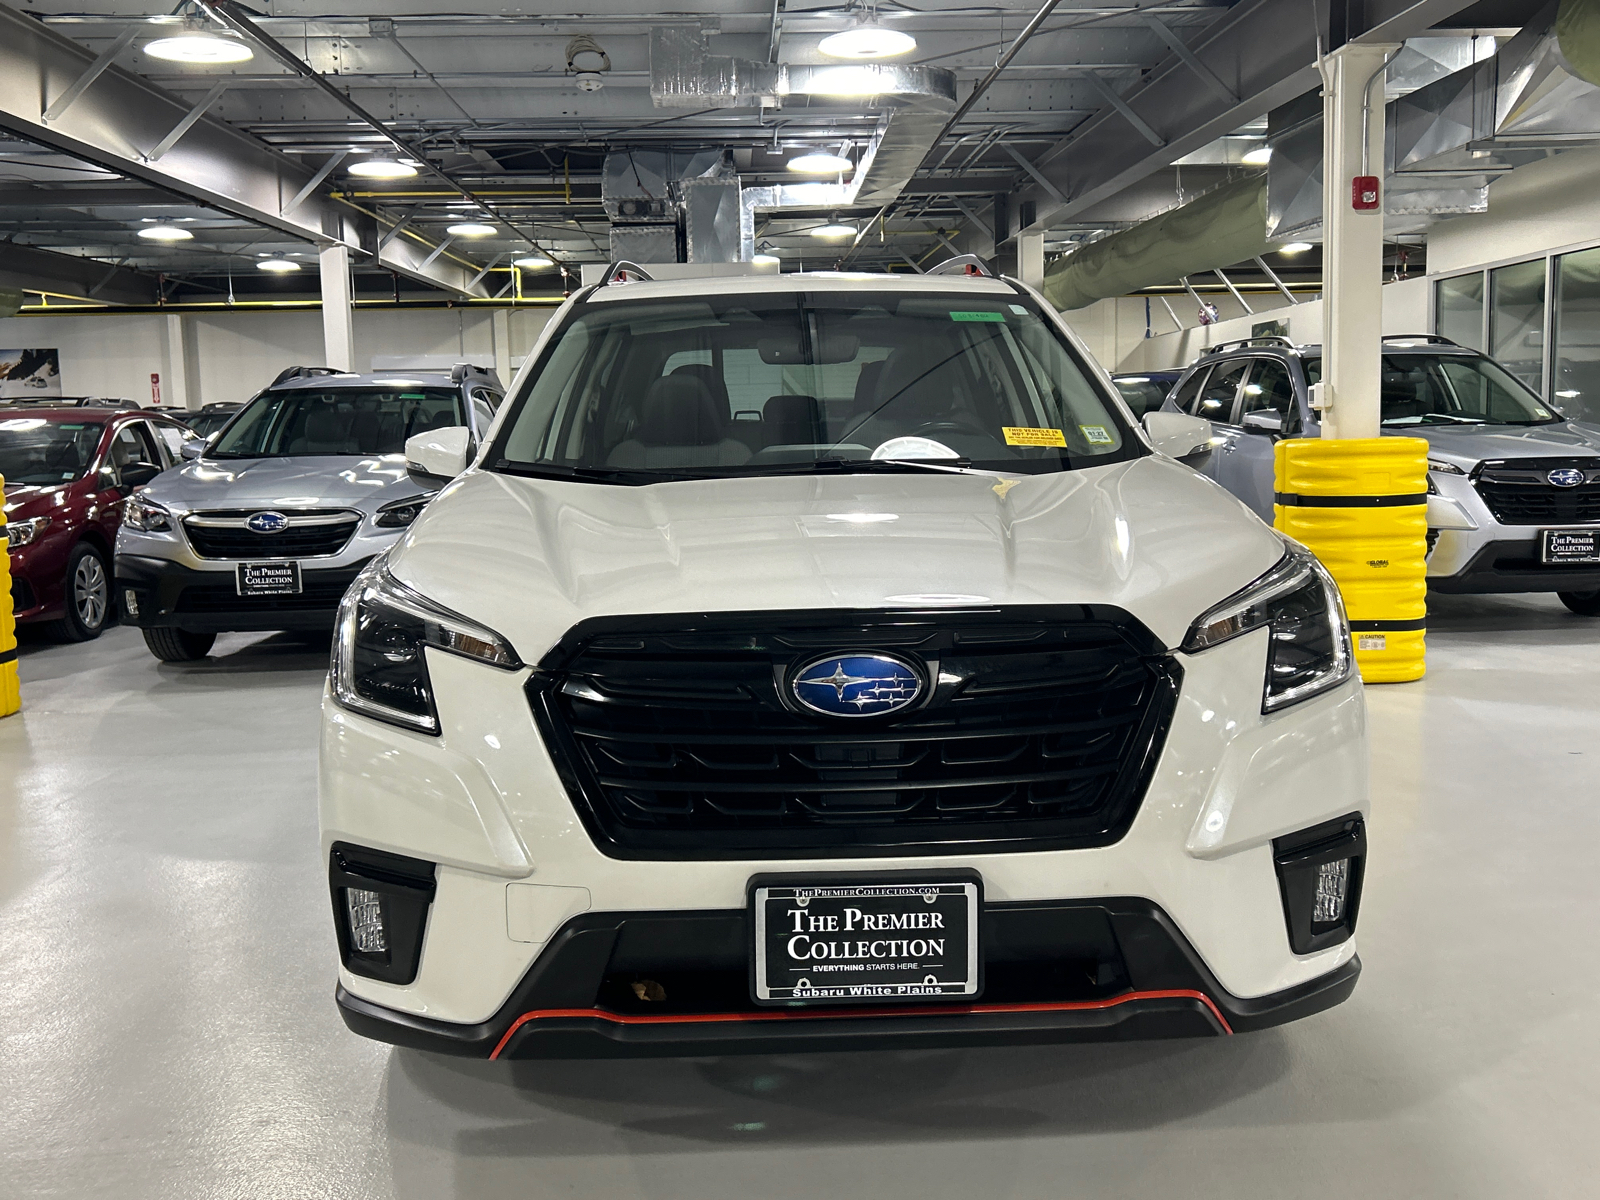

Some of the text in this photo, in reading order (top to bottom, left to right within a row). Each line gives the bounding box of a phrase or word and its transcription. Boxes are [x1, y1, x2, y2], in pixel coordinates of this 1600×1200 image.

[787, 907, 945, 933] THE PREMIER
[787, 934, 946, 960] COLLECTION
[812, 962, 920, 972] EVERYTHING STARTS HERE.
[792, 985, 943, 997] Subaru White Plains
